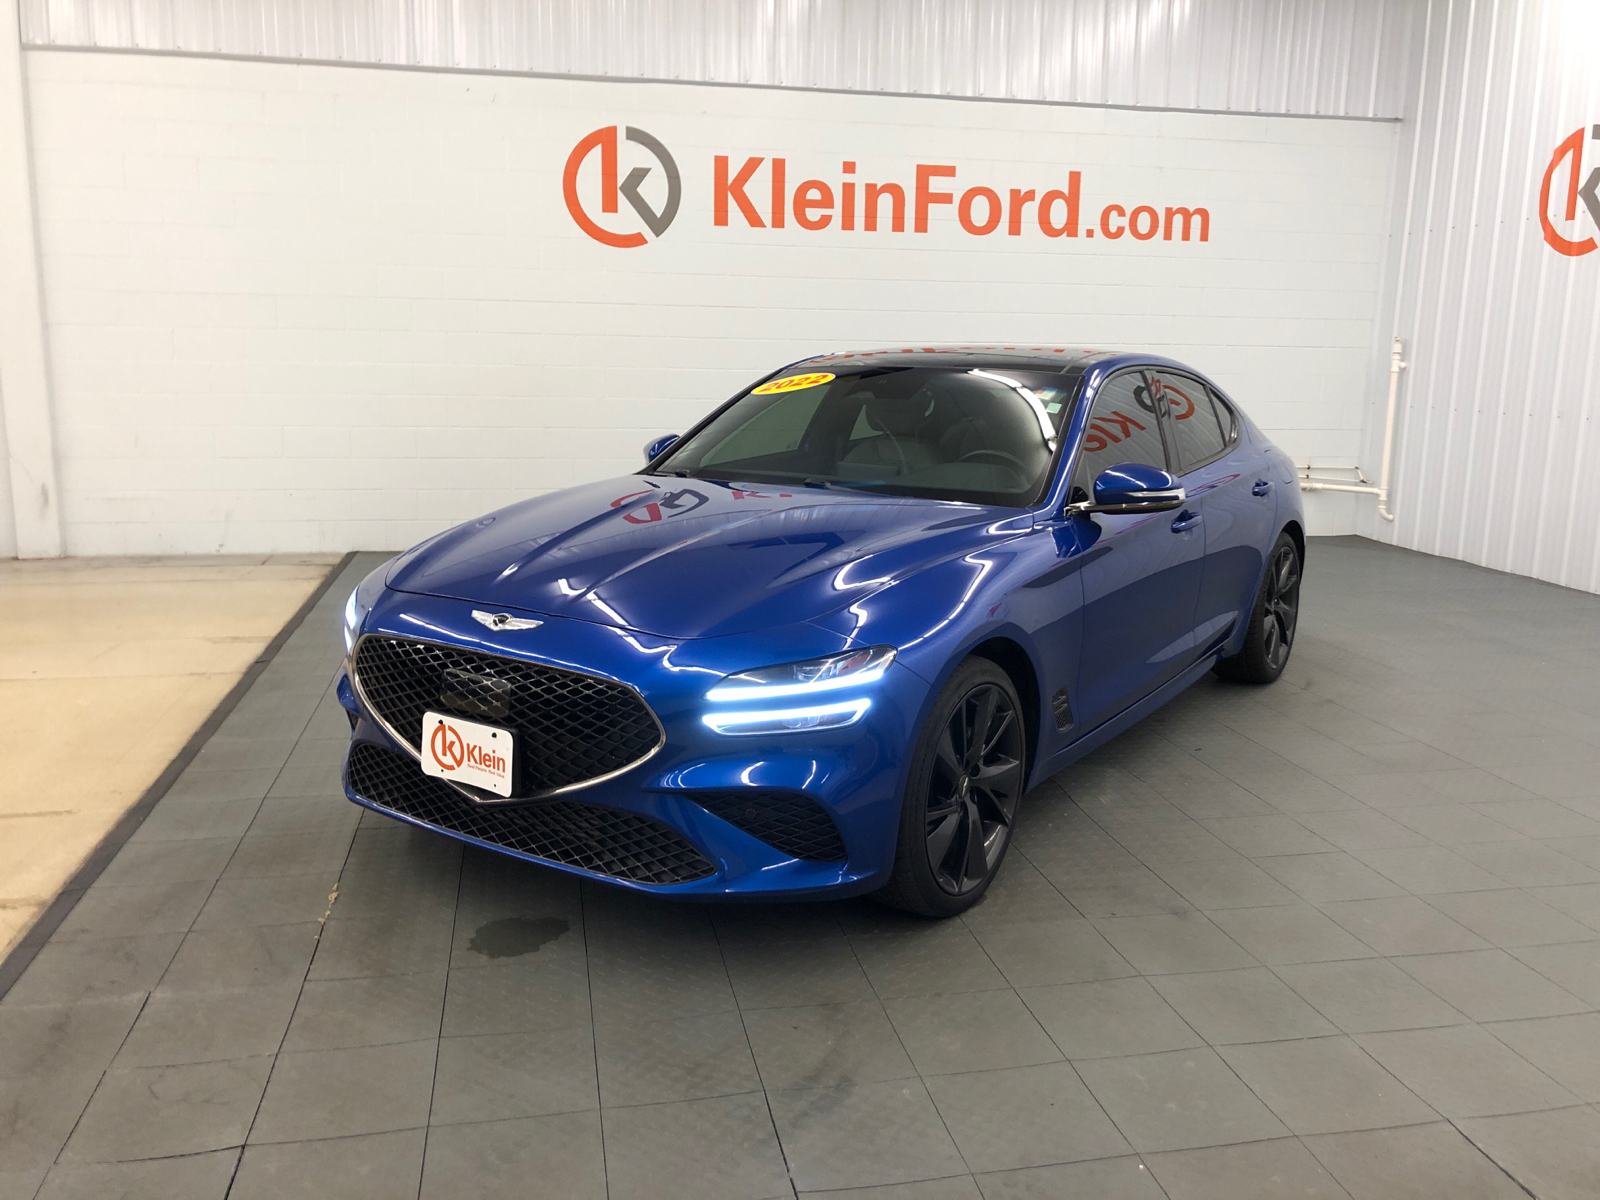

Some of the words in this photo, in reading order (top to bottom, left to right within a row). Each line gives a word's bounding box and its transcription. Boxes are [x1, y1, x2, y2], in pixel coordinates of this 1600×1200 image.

[713, 155, 1211, 242] KleinFord.com
[757, 374, 830, 393] 2022
[466, 742, 506, 774] Klein
